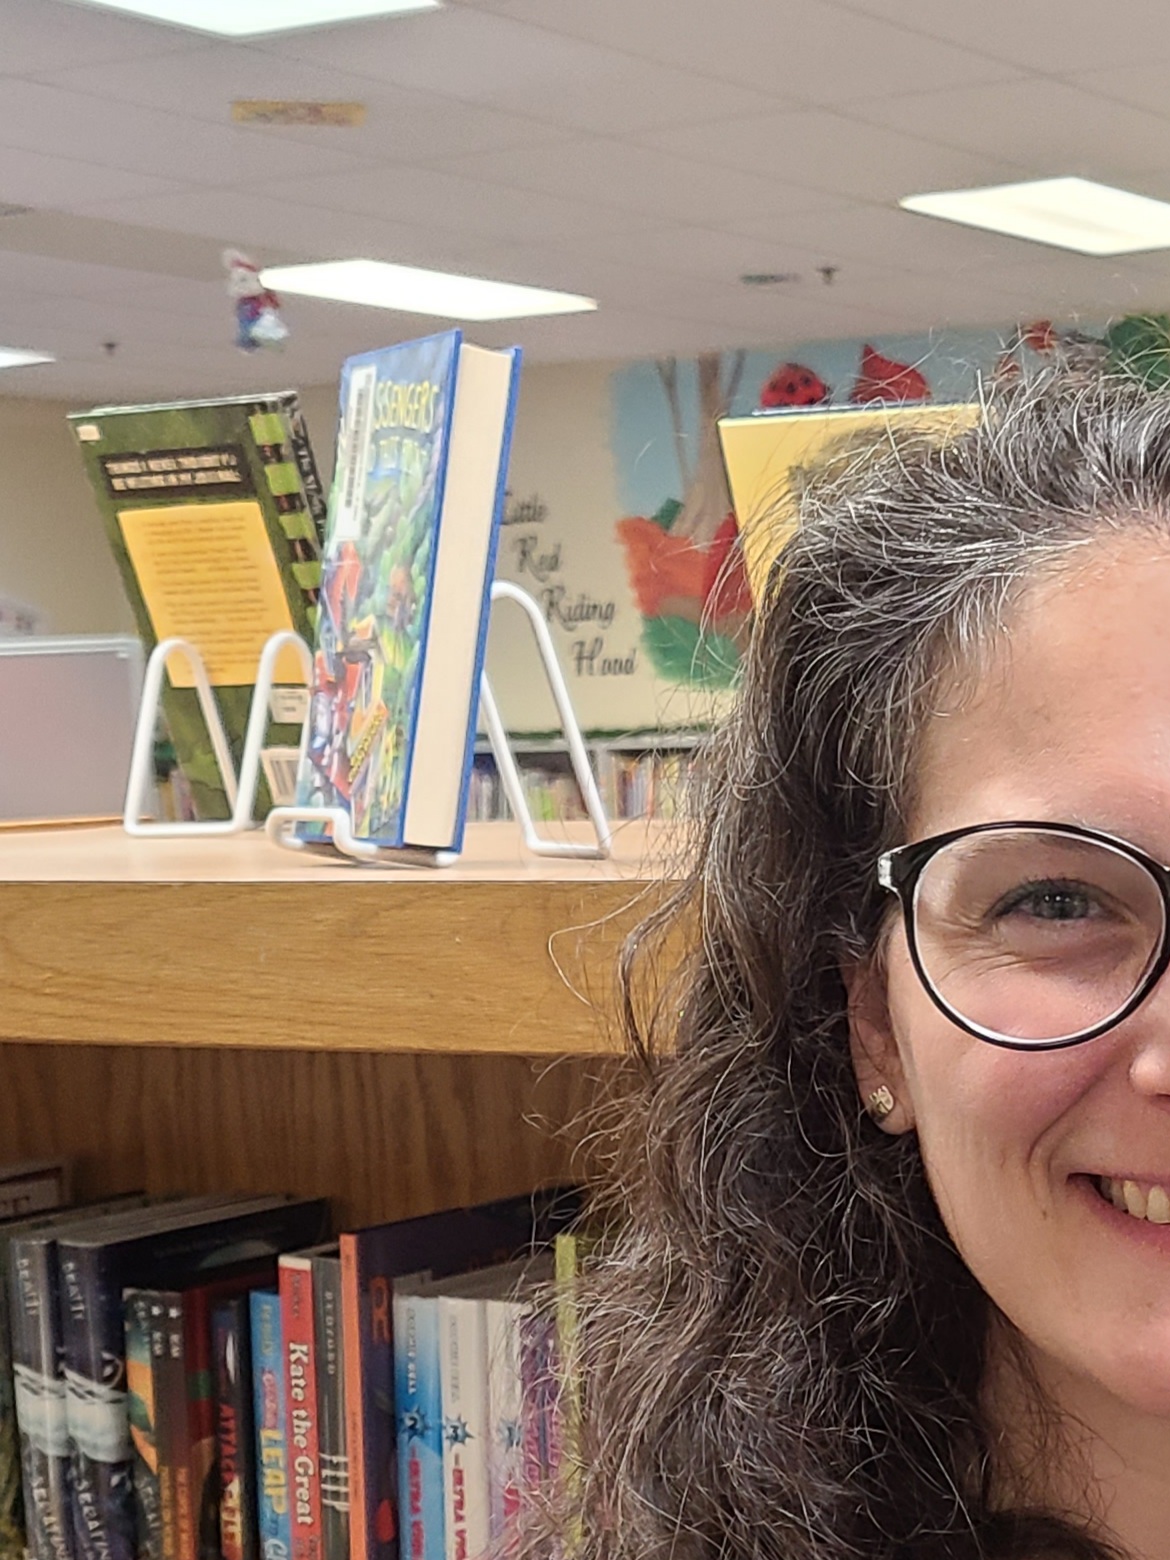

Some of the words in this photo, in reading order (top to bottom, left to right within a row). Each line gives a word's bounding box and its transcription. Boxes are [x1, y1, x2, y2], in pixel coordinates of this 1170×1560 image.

[513, 536, 562, 583] Red
[541, 585, 616, 632] Riding
[572, 636, 637, 677] Hood
[289, 1342, 309, 1401] Kate
[292, 1409, 312, 1449] the
[259, 1428, 287, 1515] LEAP
[294, 1455, 315, 1525] Great
